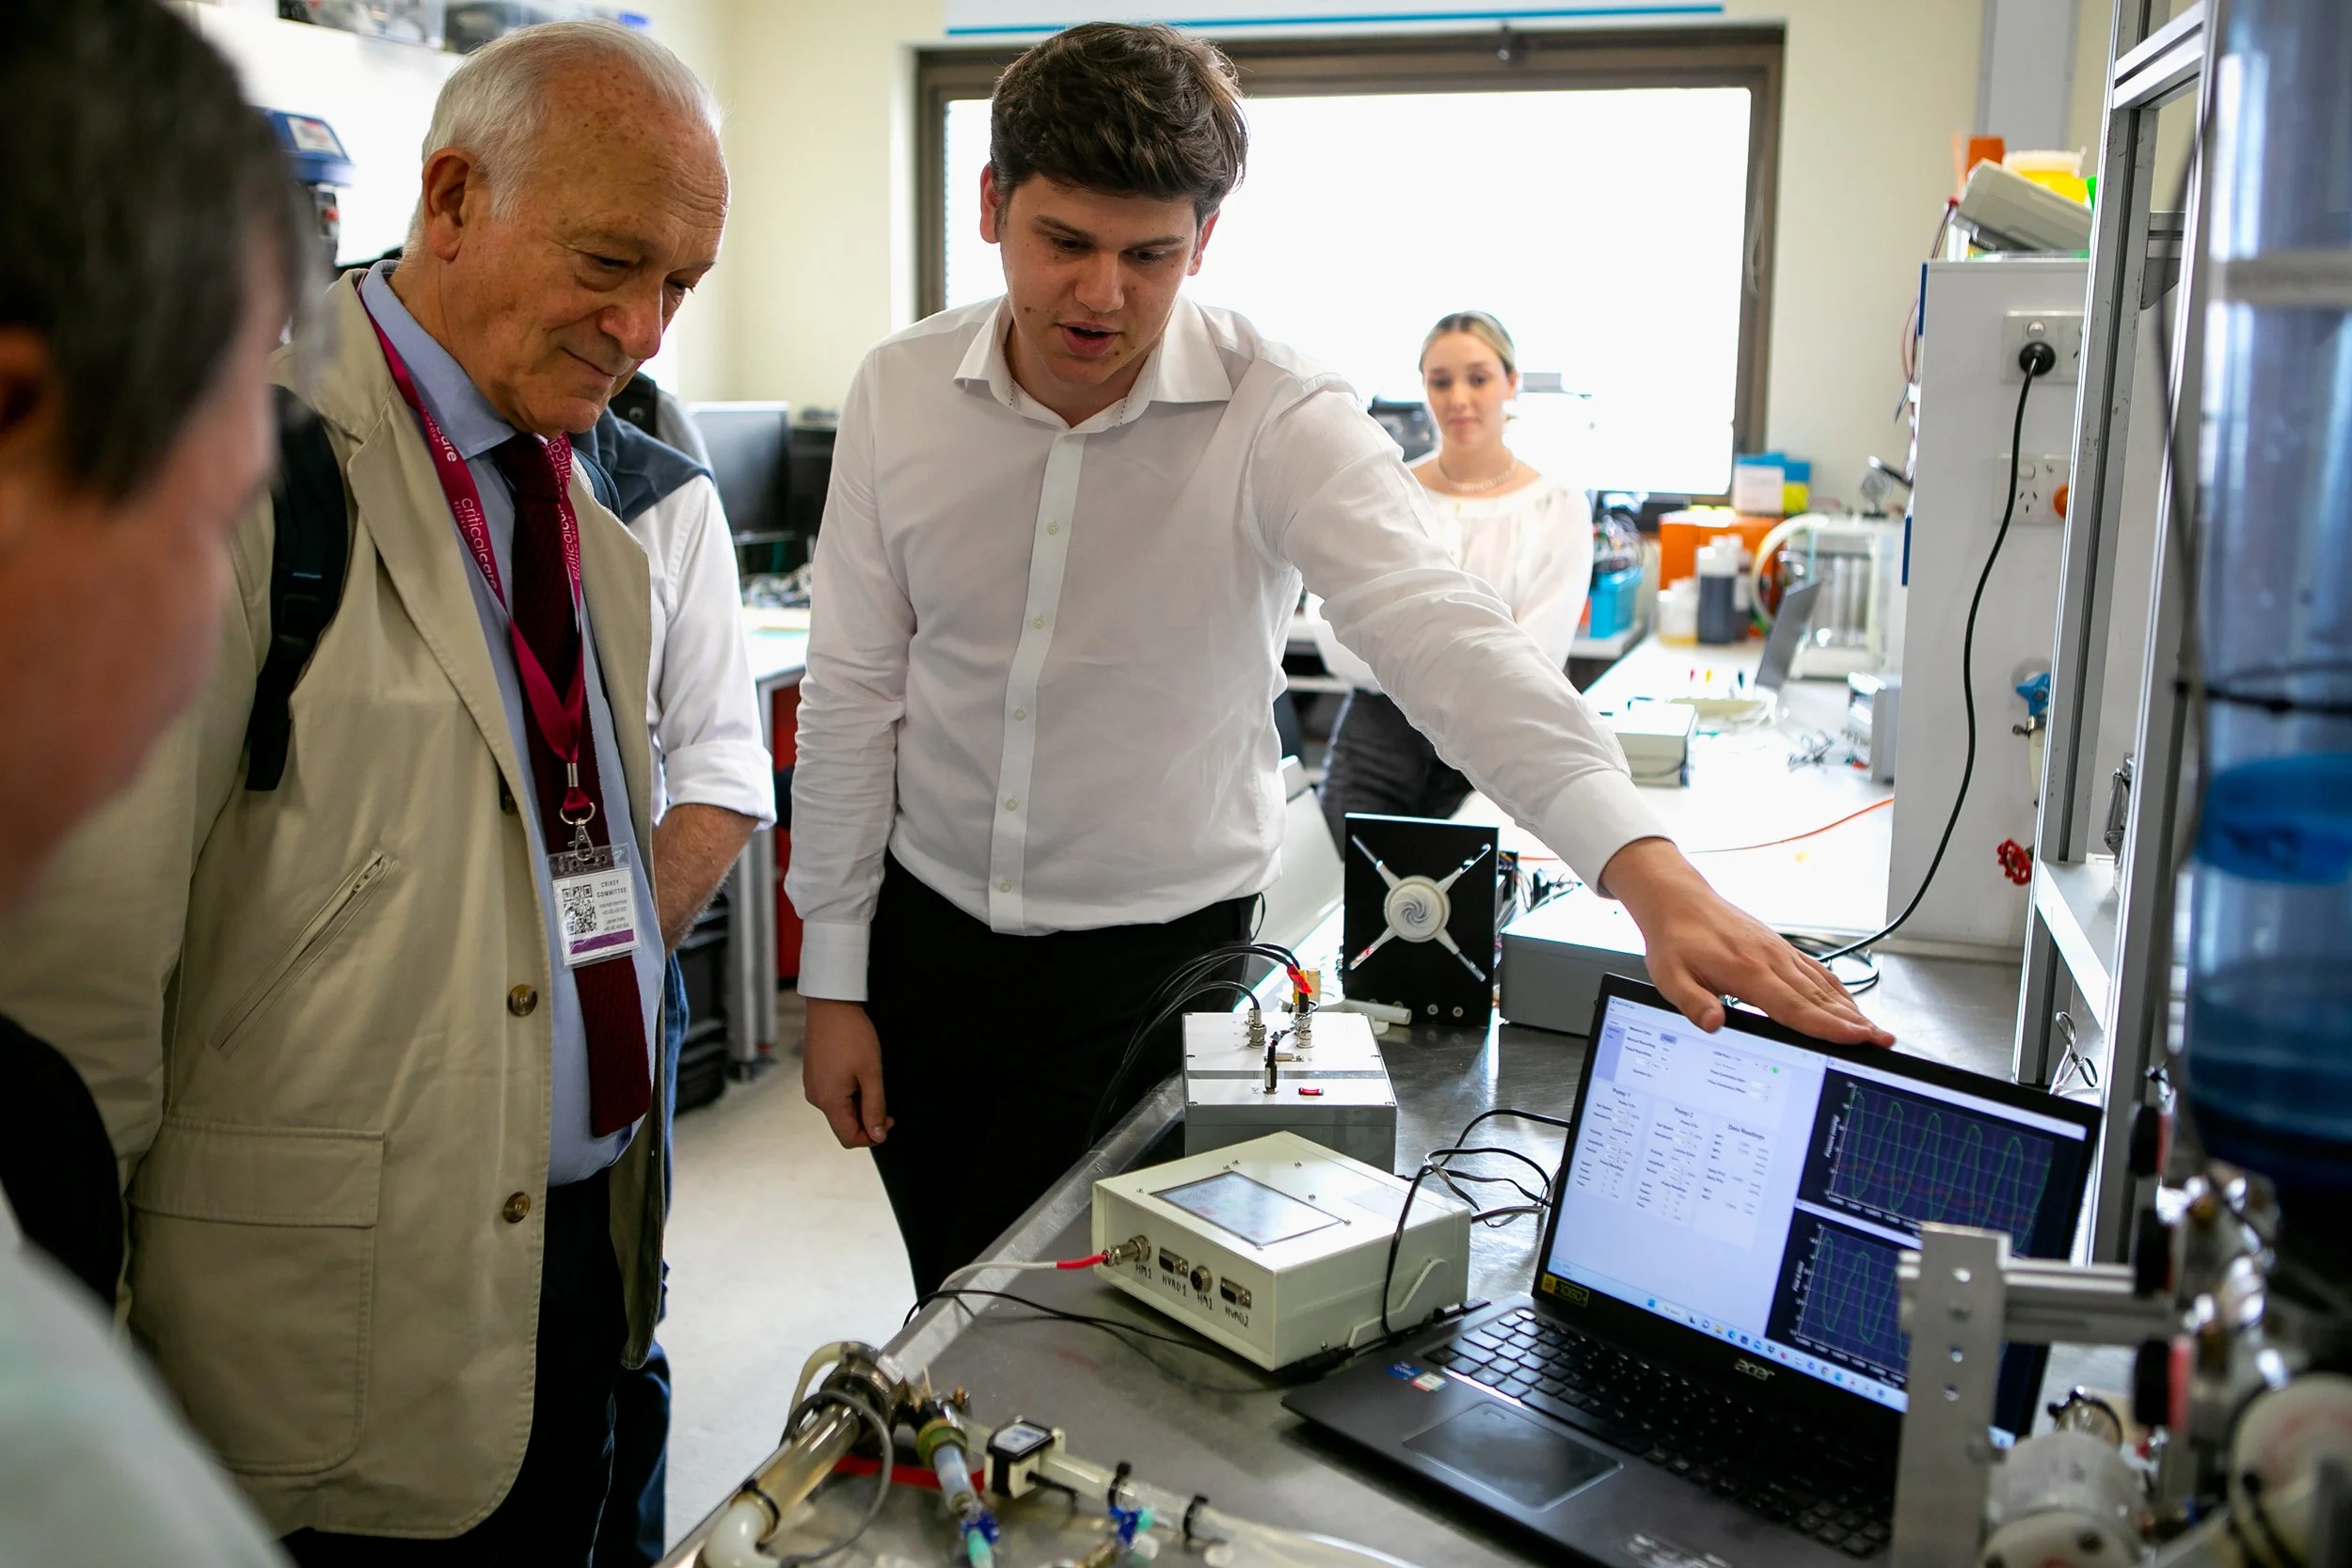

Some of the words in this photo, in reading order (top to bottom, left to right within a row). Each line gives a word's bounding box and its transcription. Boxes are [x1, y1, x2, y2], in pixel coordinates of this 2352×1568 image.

[461, 498, 498, 590] criticalcare
[1136, 1264, 1152, 1279] HM1
[1734, 1357, 1775, 1382] acer
